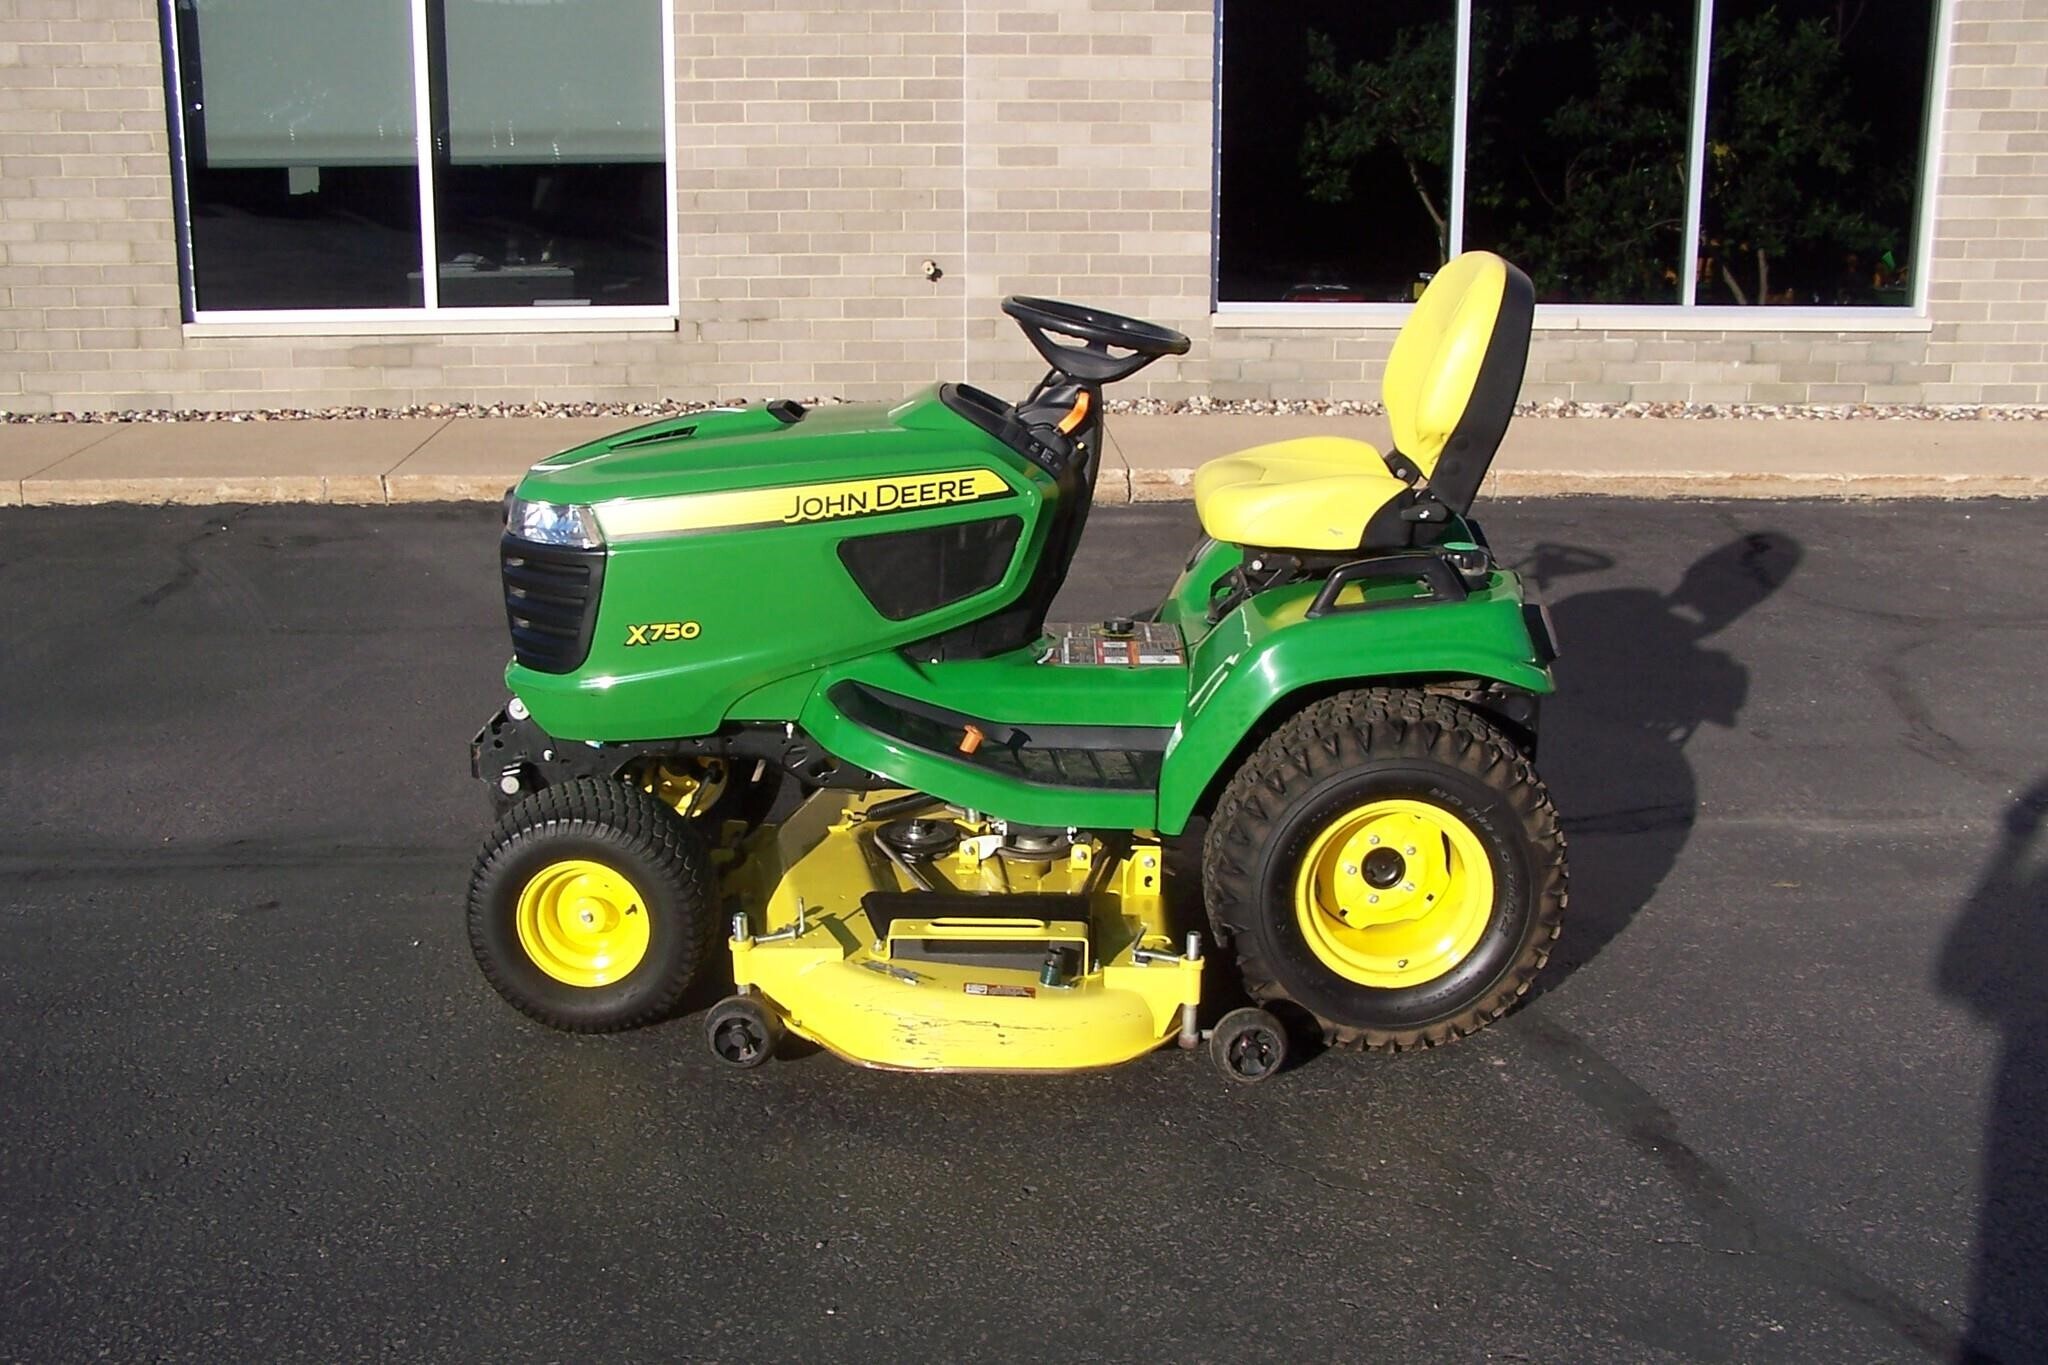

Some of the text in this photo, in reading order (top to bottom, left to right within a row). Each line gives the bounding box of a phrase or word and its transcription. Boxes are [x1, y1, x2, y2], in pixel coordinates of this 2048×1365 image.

[785, 478, 975, 519] JOHN DEERE
[624, 621, 701, 646] X750
